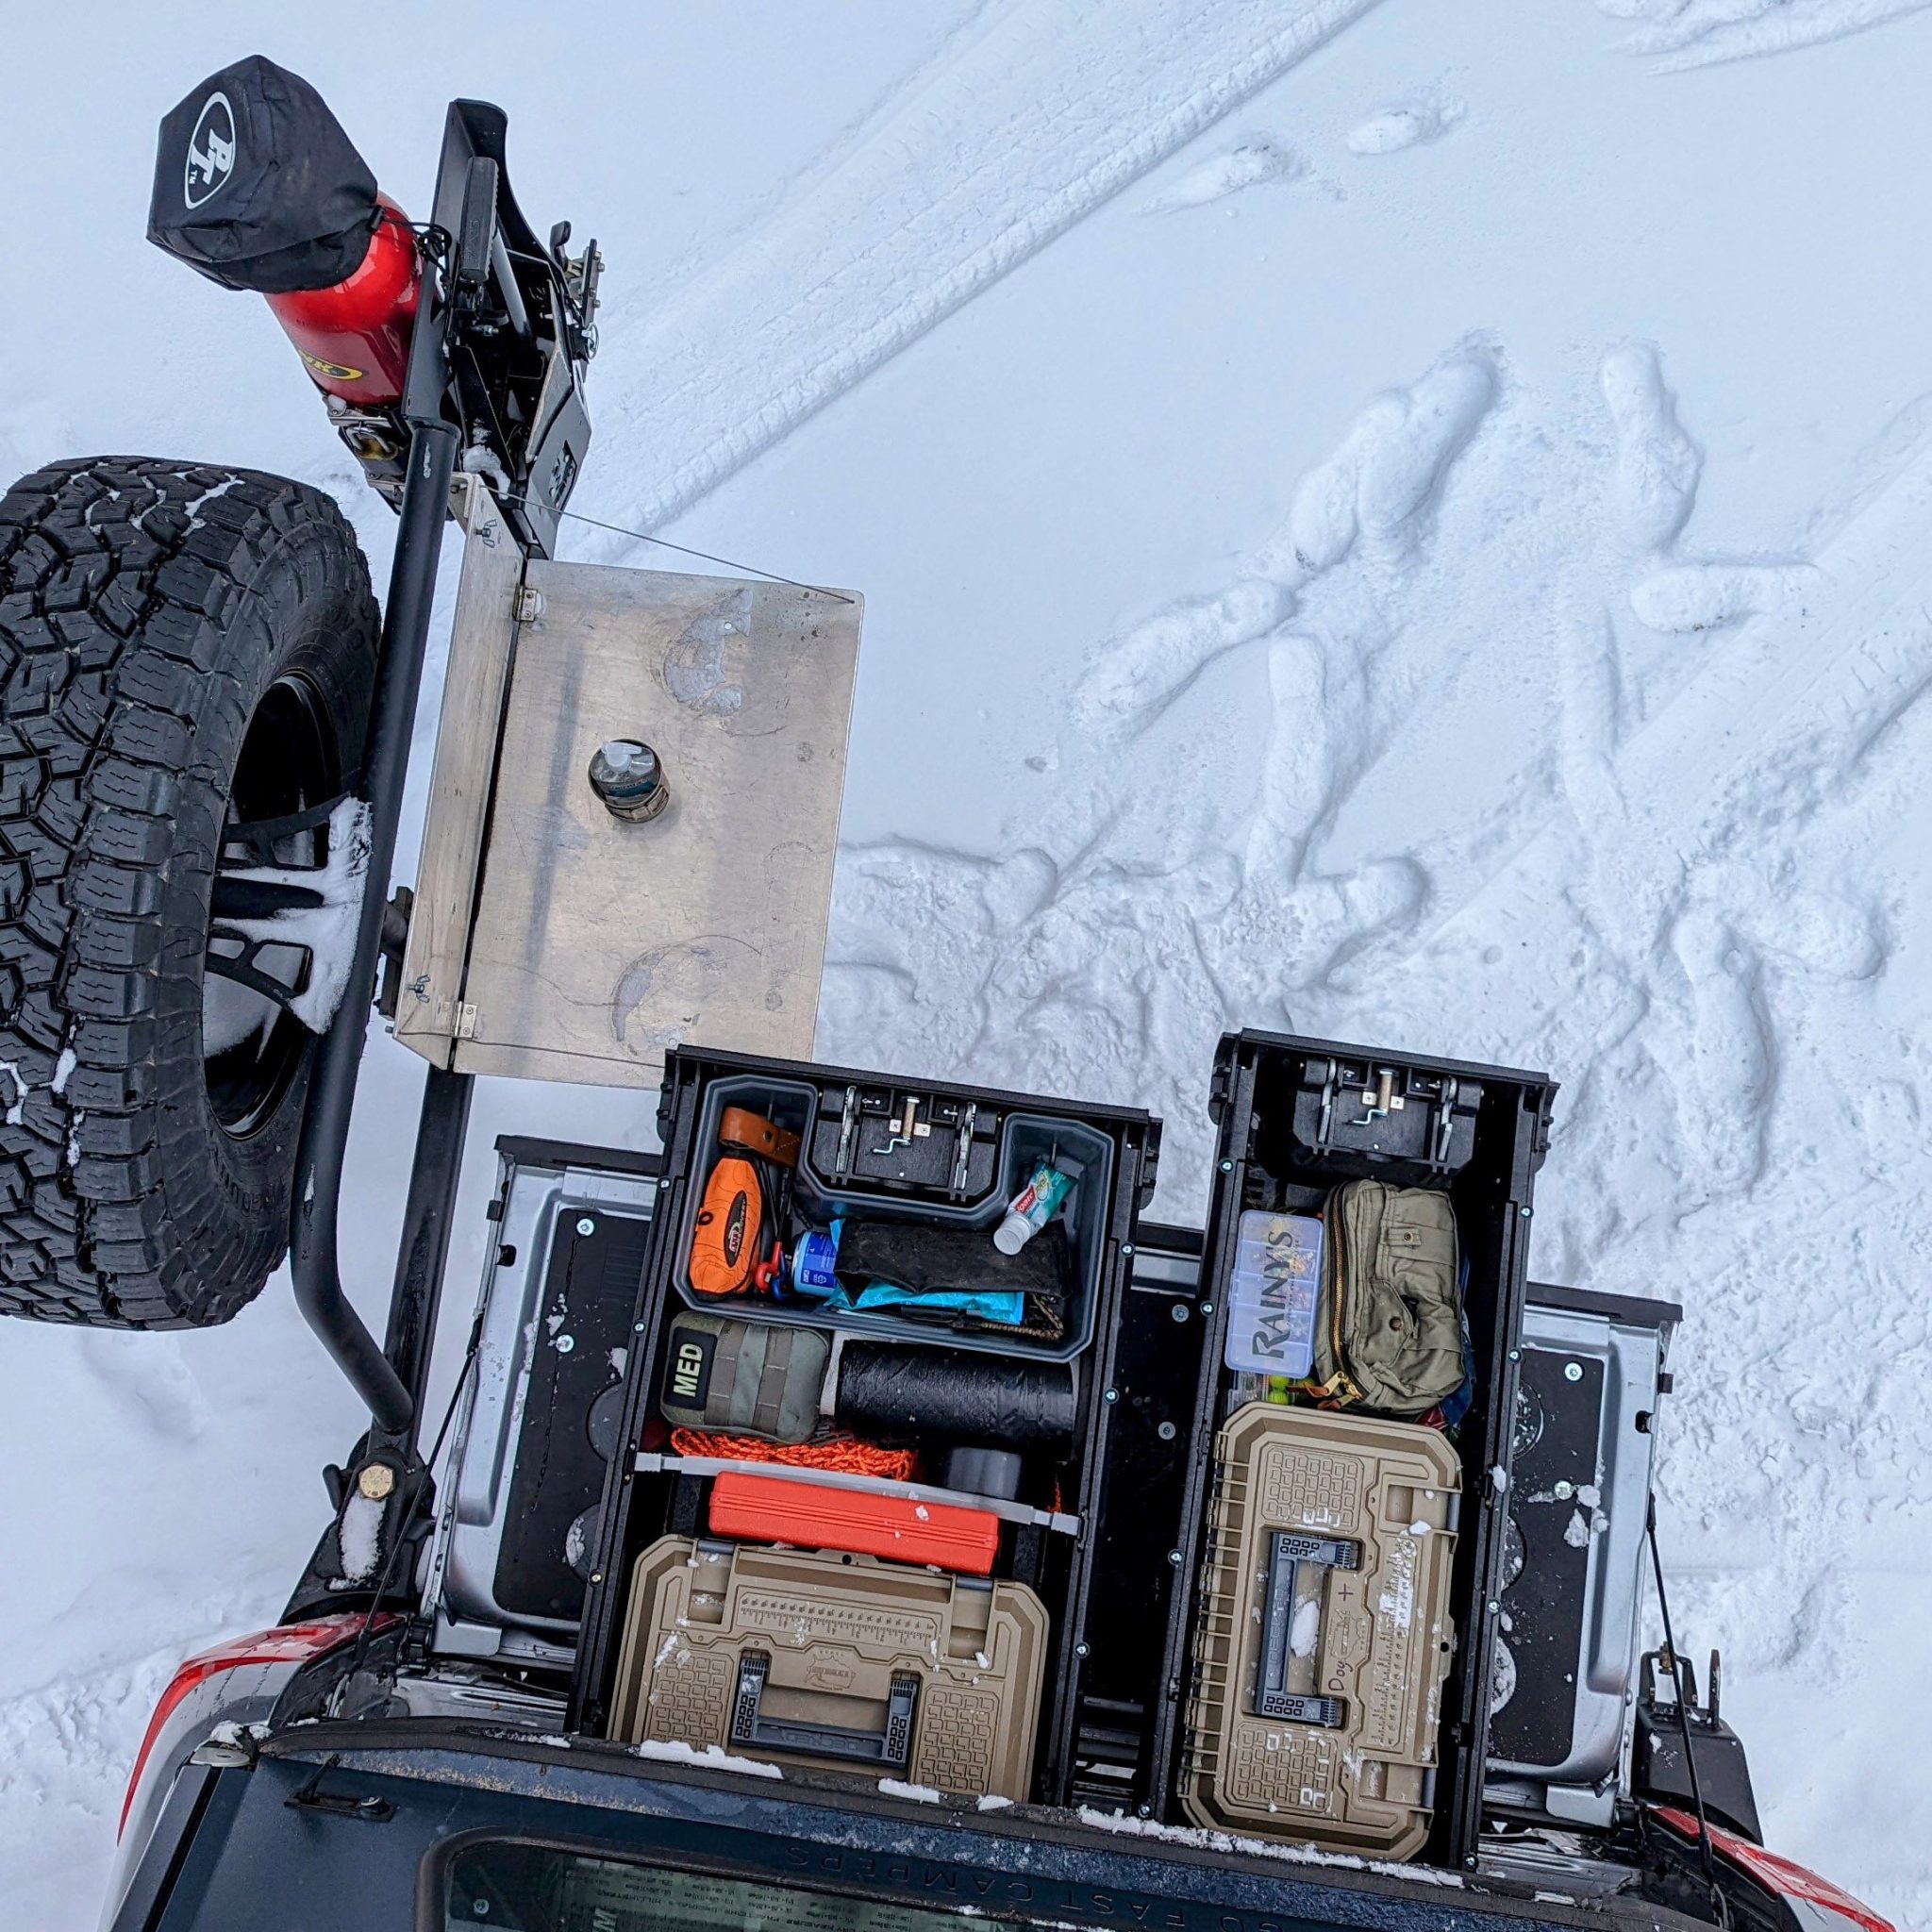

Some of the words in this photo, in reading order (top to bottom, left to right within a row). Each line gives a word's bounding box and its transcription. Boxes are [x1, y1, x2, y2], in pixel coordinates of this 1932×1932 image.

[673, 1342, 704, 1398] MED
[1327, 1660, 1354, 1691] Dog
[784, 1845, 1035, 1903] CAMPERS
[1060, 1891, 1186, 1927] FAST
